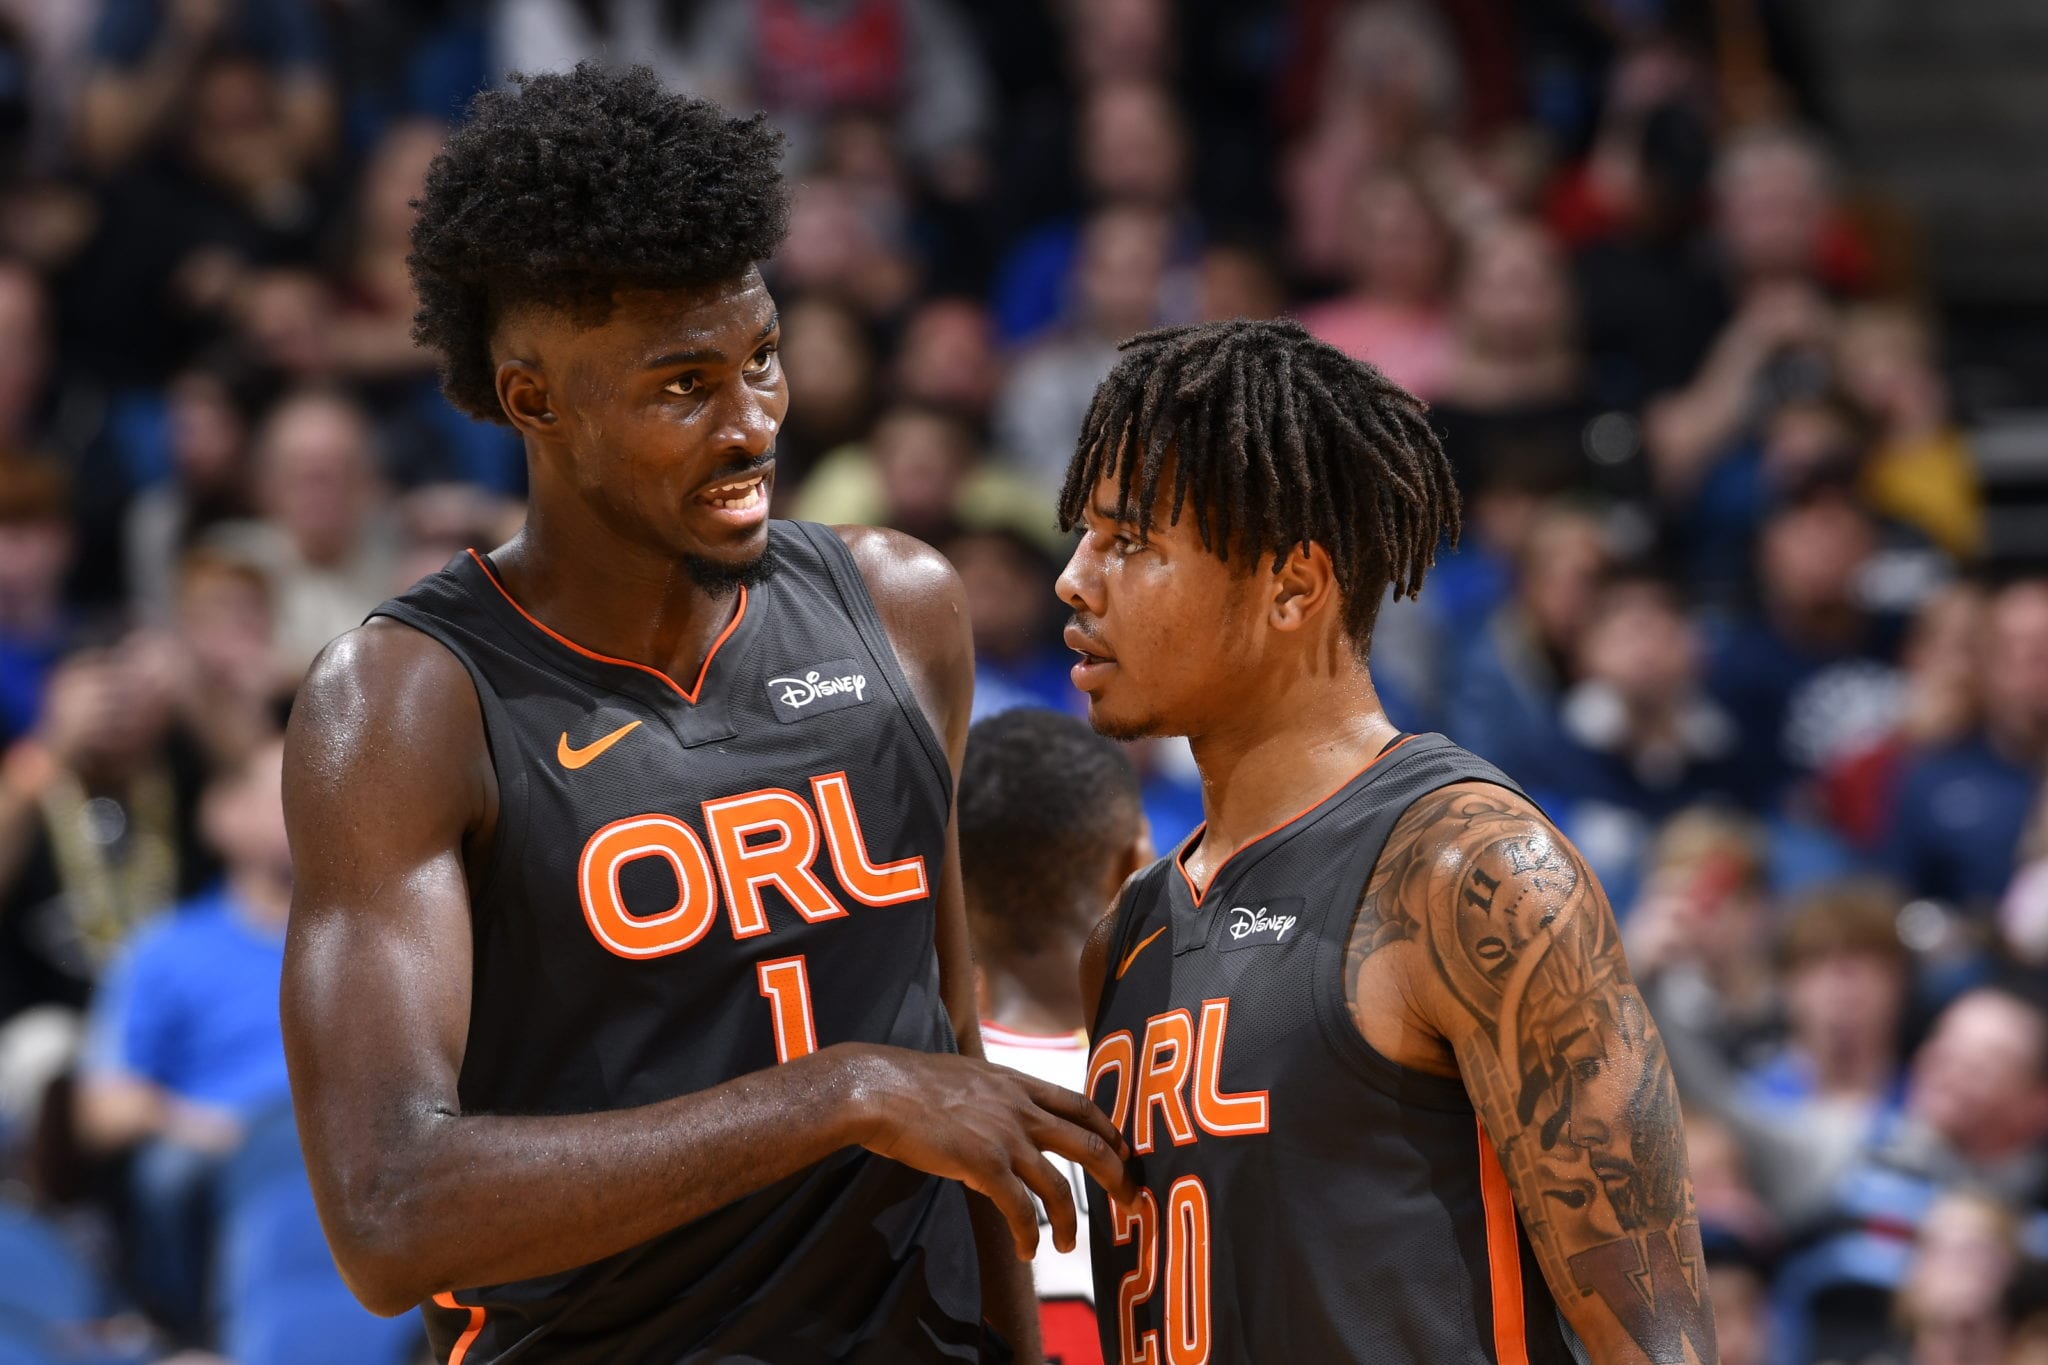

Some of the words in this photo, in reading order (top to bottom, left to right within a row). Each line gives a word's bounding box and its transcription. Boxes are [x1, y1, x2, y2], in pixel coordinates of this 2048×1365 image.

[577, 771, 930, 960] ORL
[757, 955, 818, 1065] 1
[1085, 997, 1270, 1155] ORL
[1108, 1174, 1212, 1365] 20
